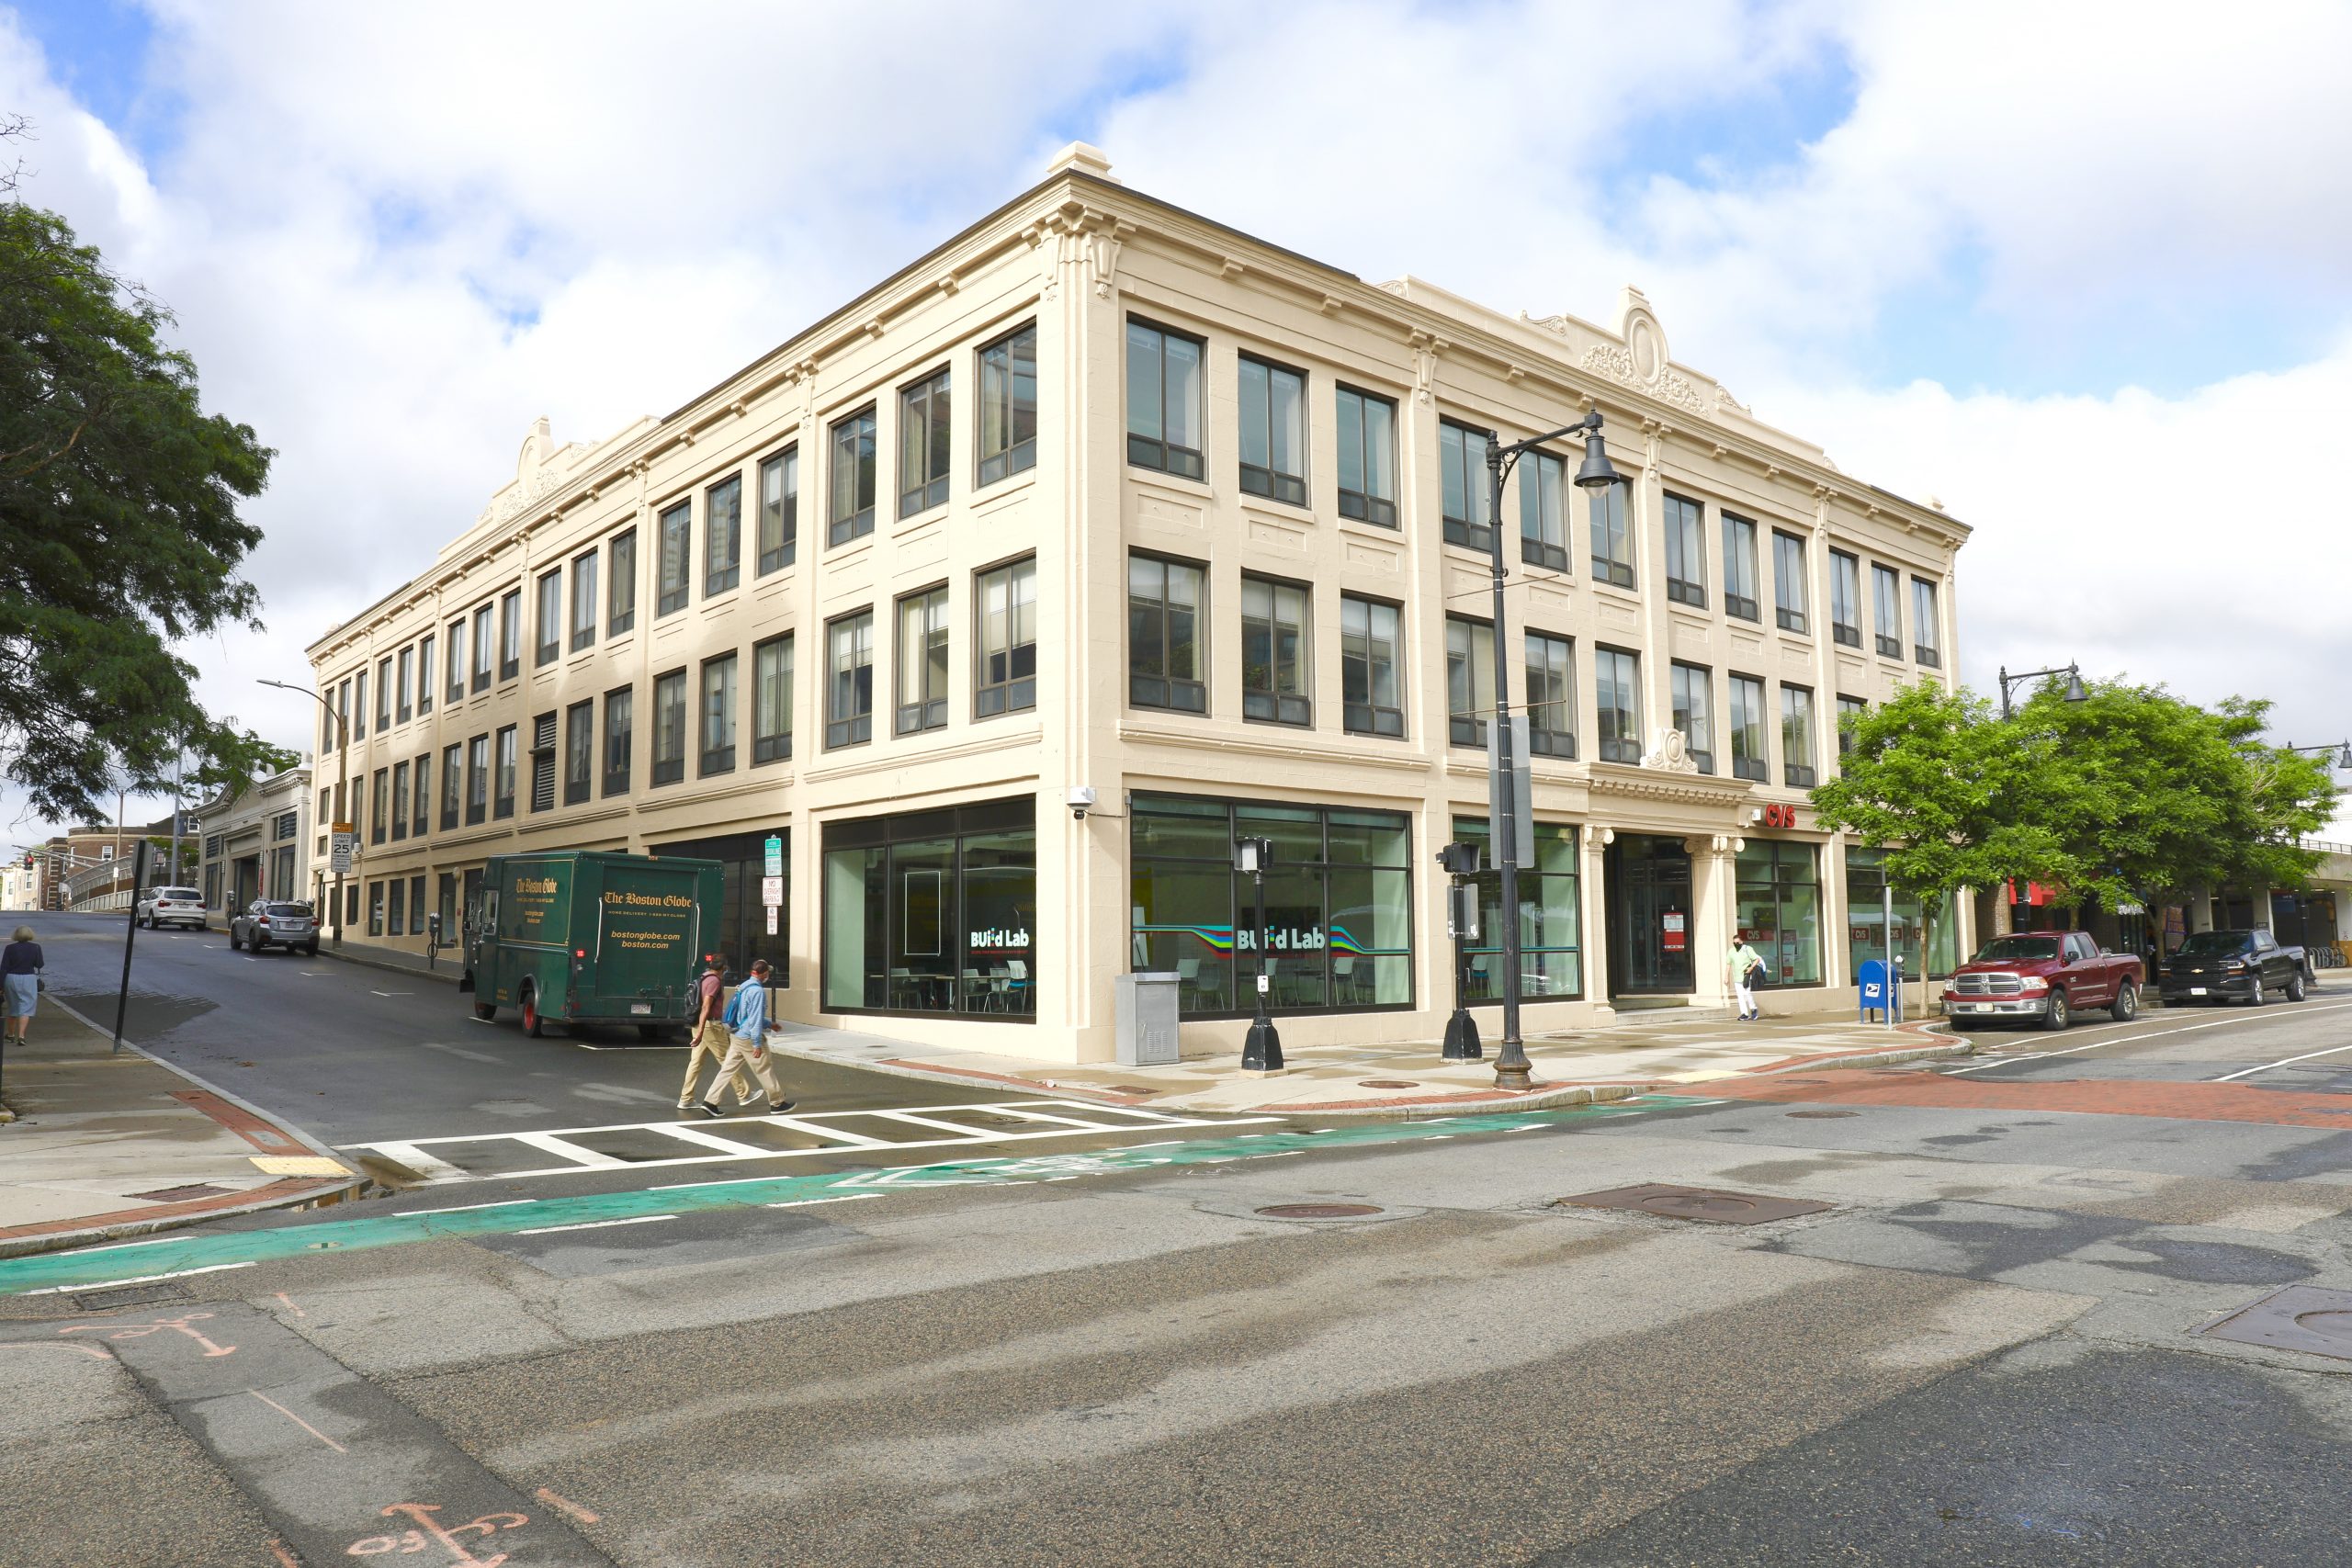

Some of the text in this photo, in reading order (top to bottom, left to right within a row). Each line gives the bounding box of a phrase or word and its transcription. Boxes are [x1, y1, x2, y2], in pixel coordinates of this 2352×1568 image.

[1766, 804, 1795, 828] CVS
[334, 844, 349, 853] 25
[605, 891, 692, 908] The Boston Globe
[611, 931, 680, 941] bostonglobe.com
[1005, 928, 1029, 947] Lab
[1292, 927, 1325, 950] Lab
[1747, 930, 1759, 940] CVS
[1855, 930, 1866, 939] CVS
[622, 940, 669, 949] boston.com
